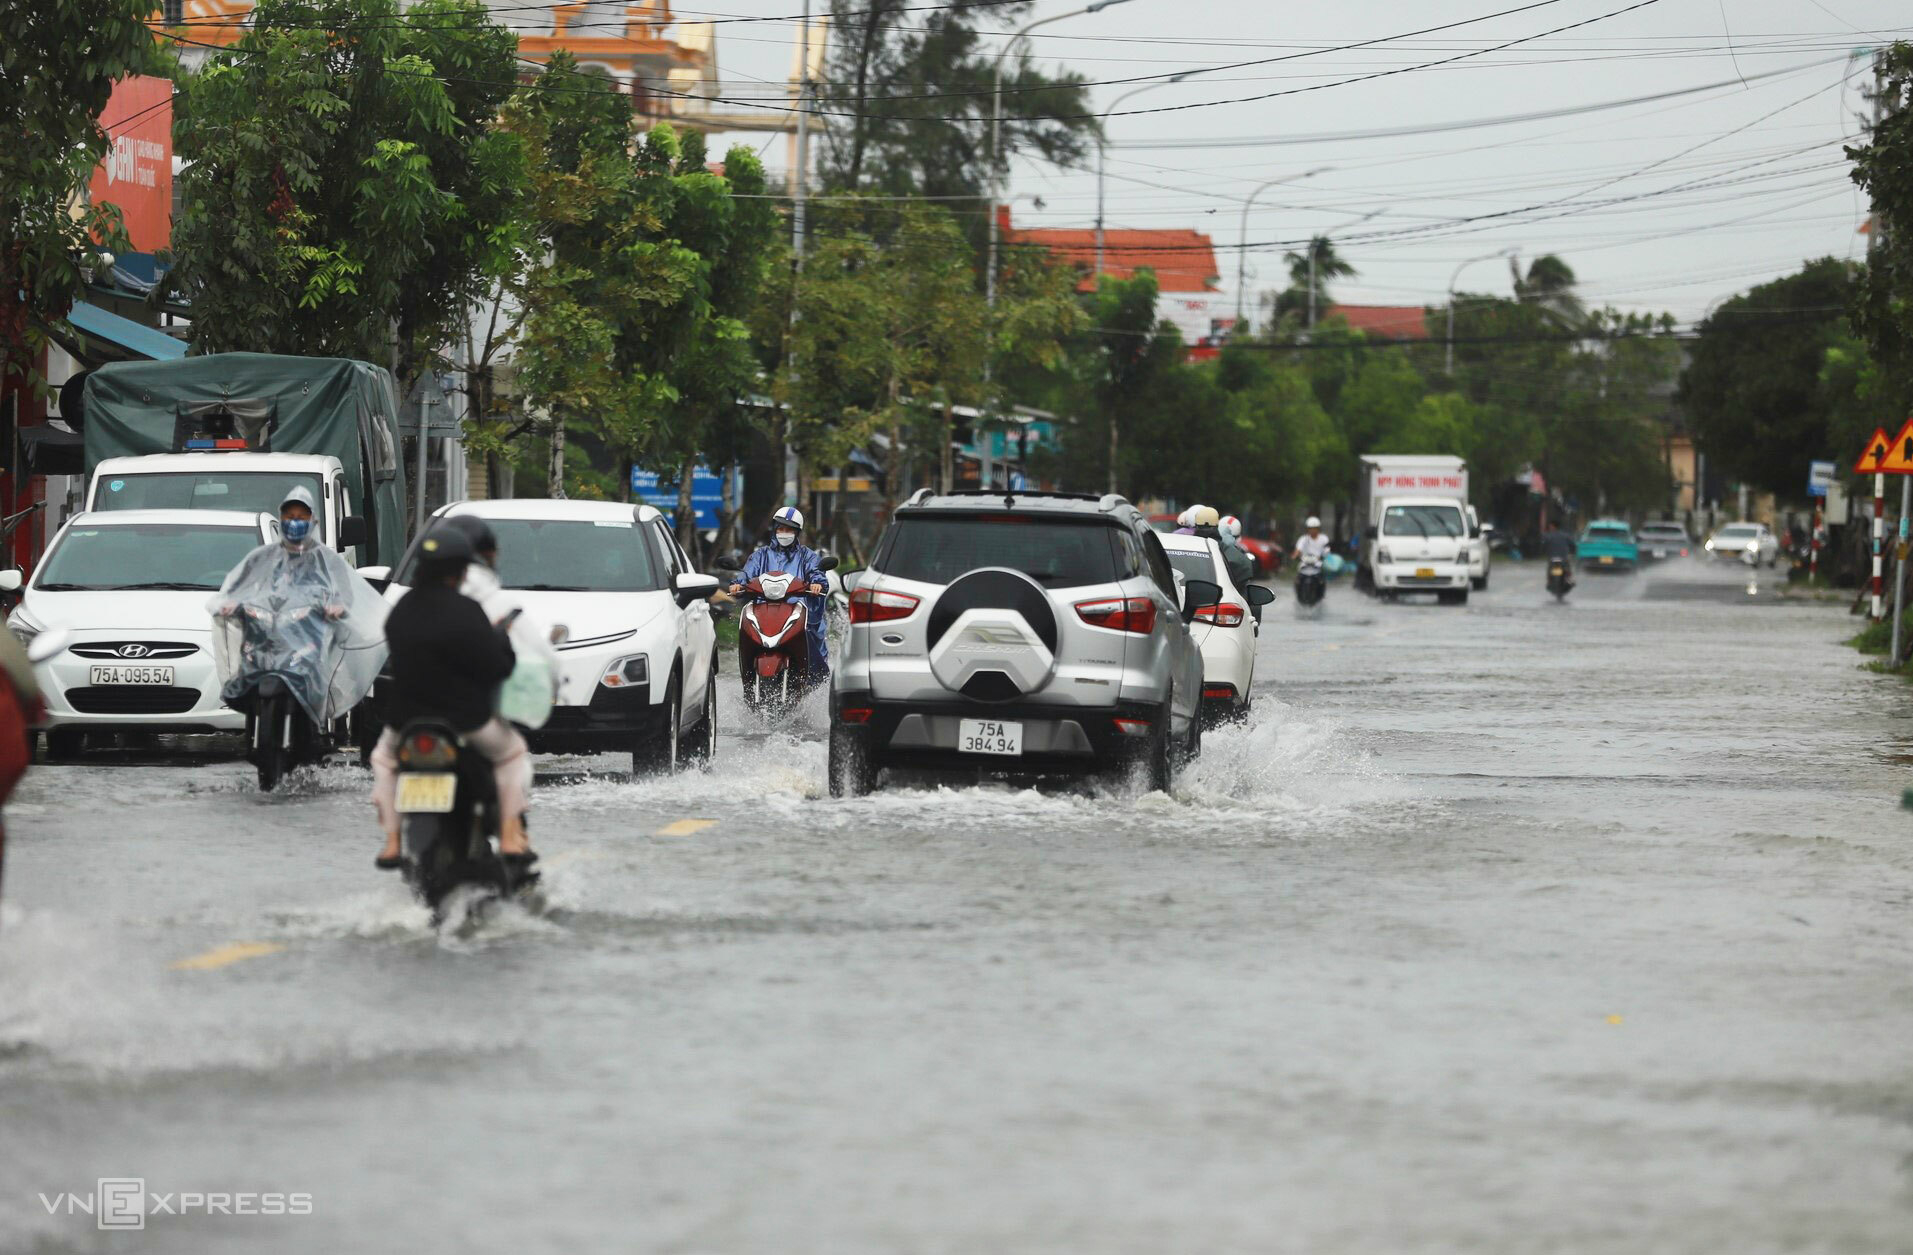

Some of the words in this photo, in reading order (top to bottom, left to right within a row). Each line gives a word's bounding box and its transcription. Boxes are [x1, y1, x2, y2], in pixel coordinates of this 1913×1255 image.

[116, 136, 134, 183] GHN
[93, 667, 171, 684] 75A-095.54
[978, 722, 1004, 737] 75A
[965, 737, 1015, 752] 384.94
